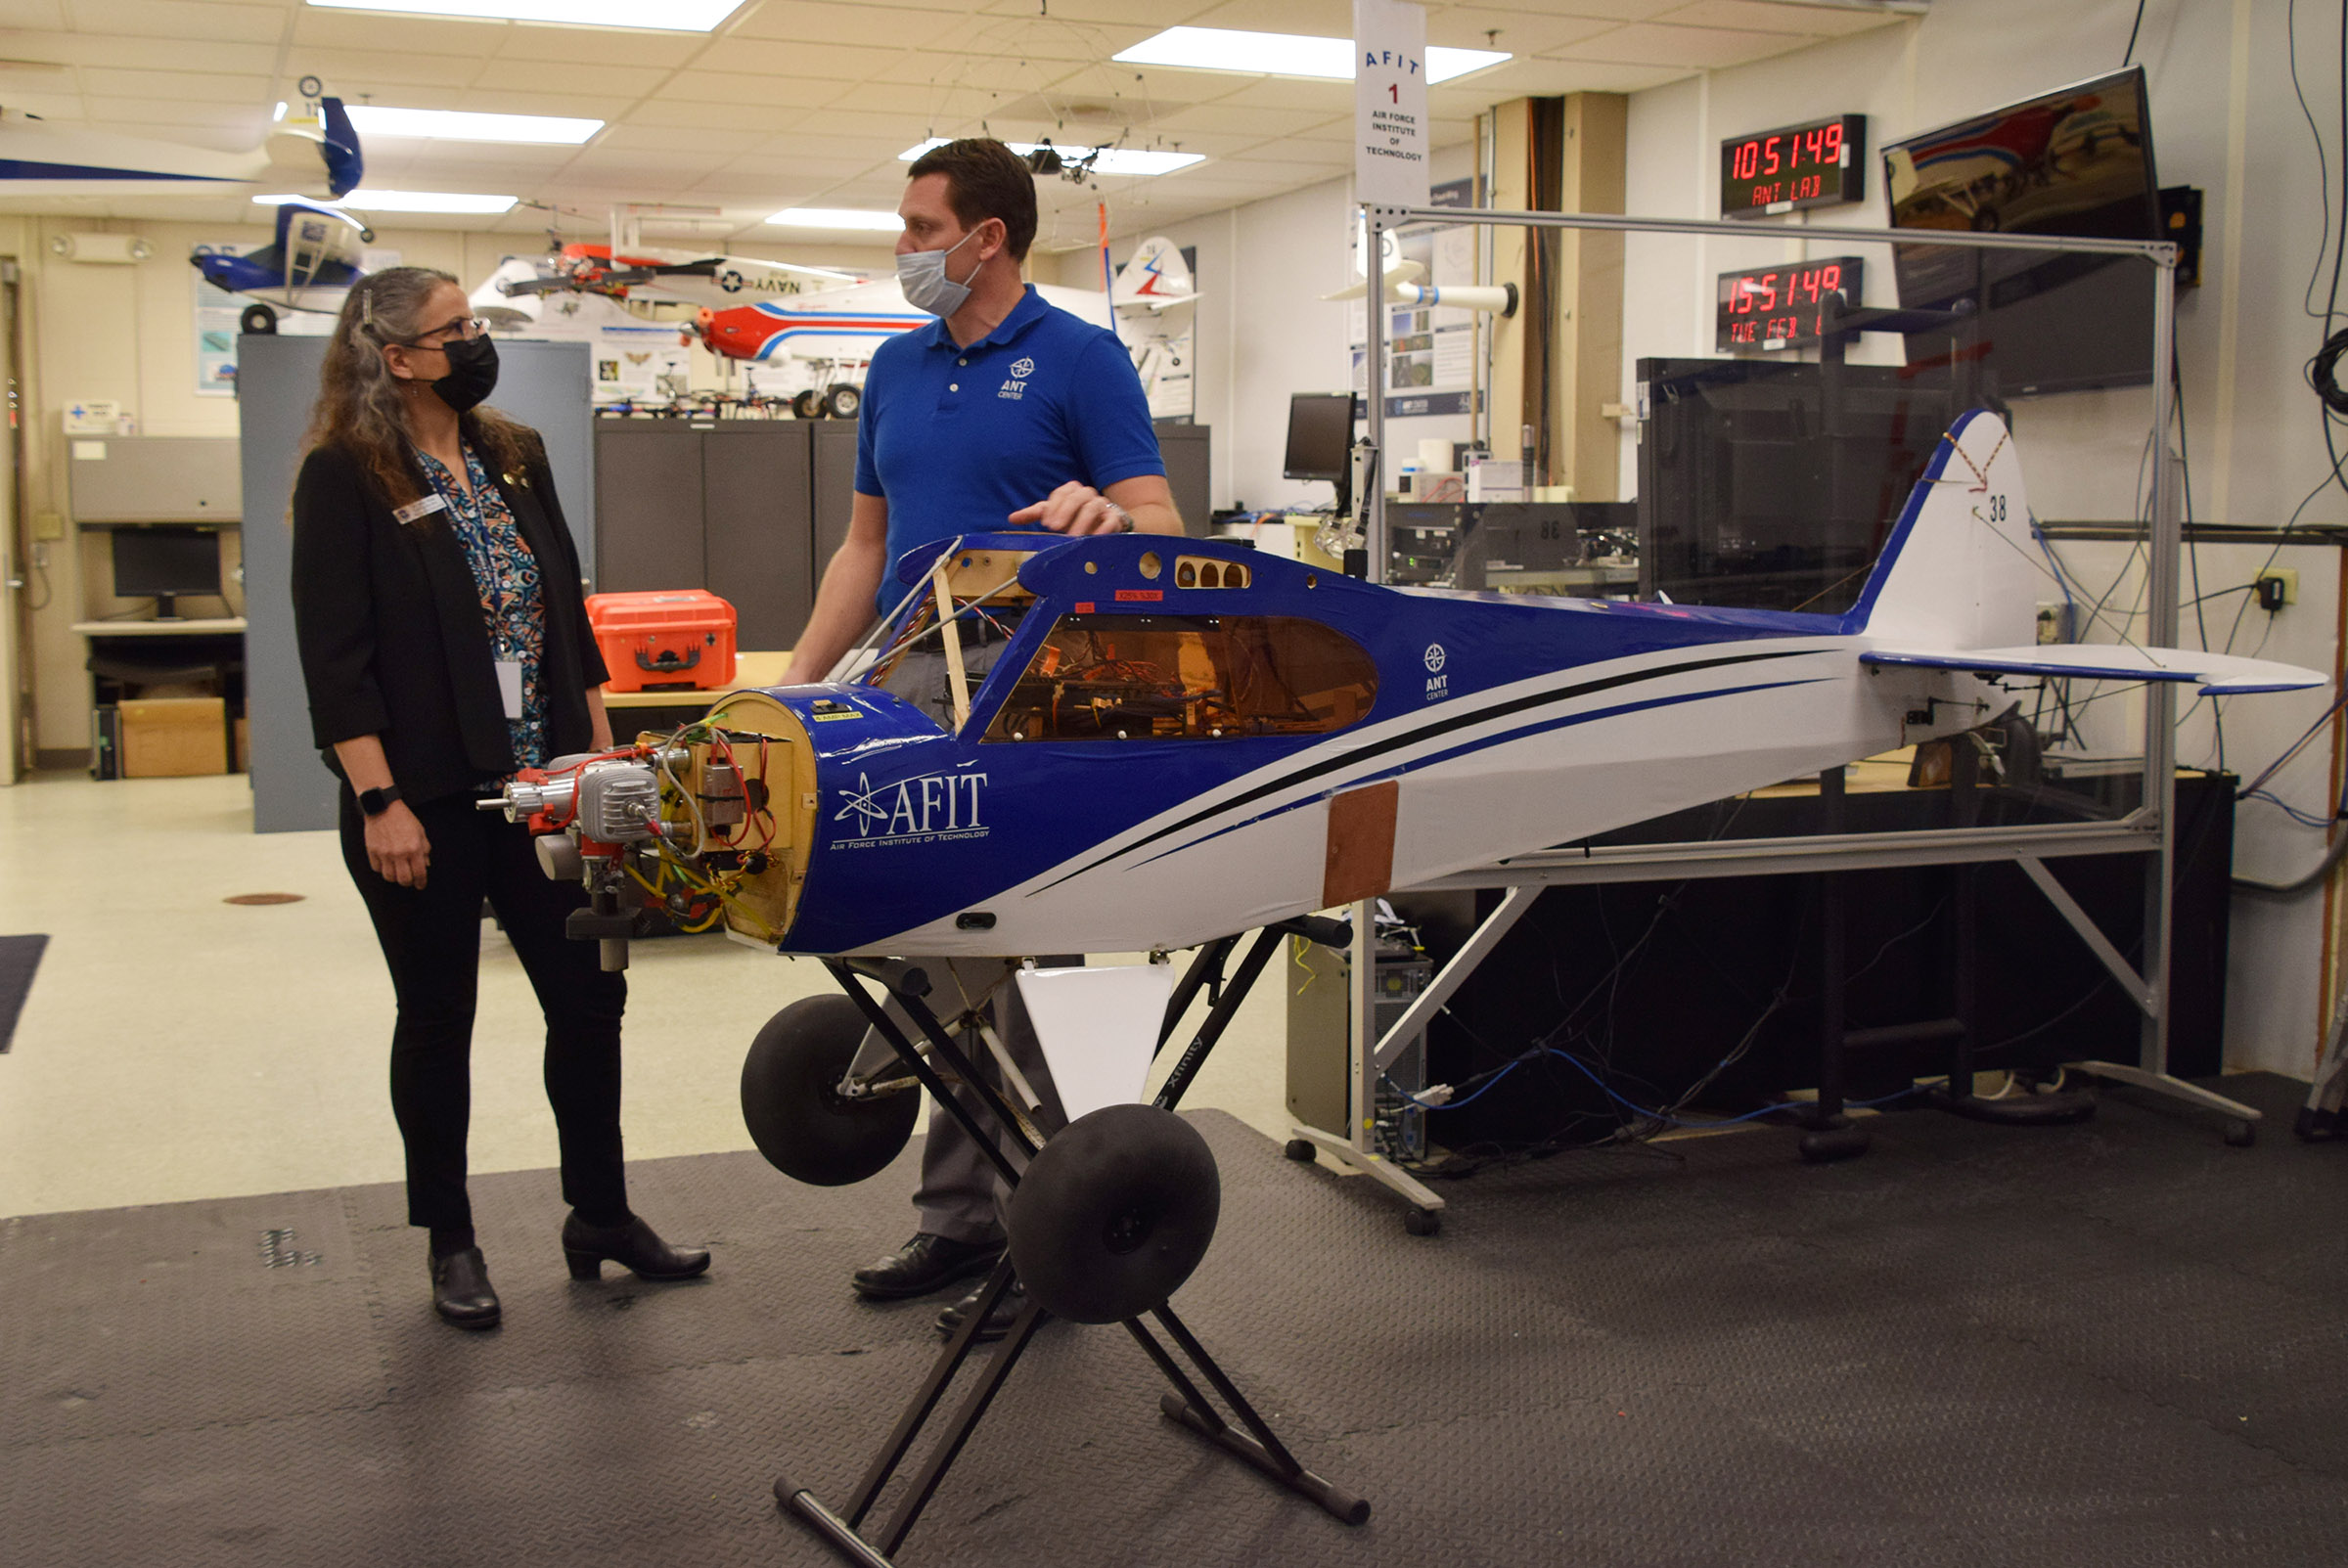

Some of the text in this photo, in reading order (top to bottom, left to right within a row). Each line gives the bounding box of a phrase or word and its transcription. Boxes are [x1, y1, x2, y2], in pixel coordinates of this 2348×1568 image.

[1366, 51, 1419, 74] AFIT
[1388, 83, 1398, 104] 1
[1373, 111, 1416, 124] AIR FORCE
[1373, 123, 1416, 136] INSTITUTE
[1366, 146, 1422, 161] TECHNOLOGY
[1752, 175, 1822, 206] ANT LAB
[754, 278, 800, 293] NAVY
[1731, 321, 1758, 343] TUE
[1767, 317, 1797, 339] FEB
[1001, 380, 1027, 392] ANT
[998, 391, 1023, 400] CENTER
[1990, 494, 2007, 522] 38
[1426, 675, 1448, 692] ANT
[1426, 689, 1448, 700] CENTER
[886, 772, 988, 834] AFIT
